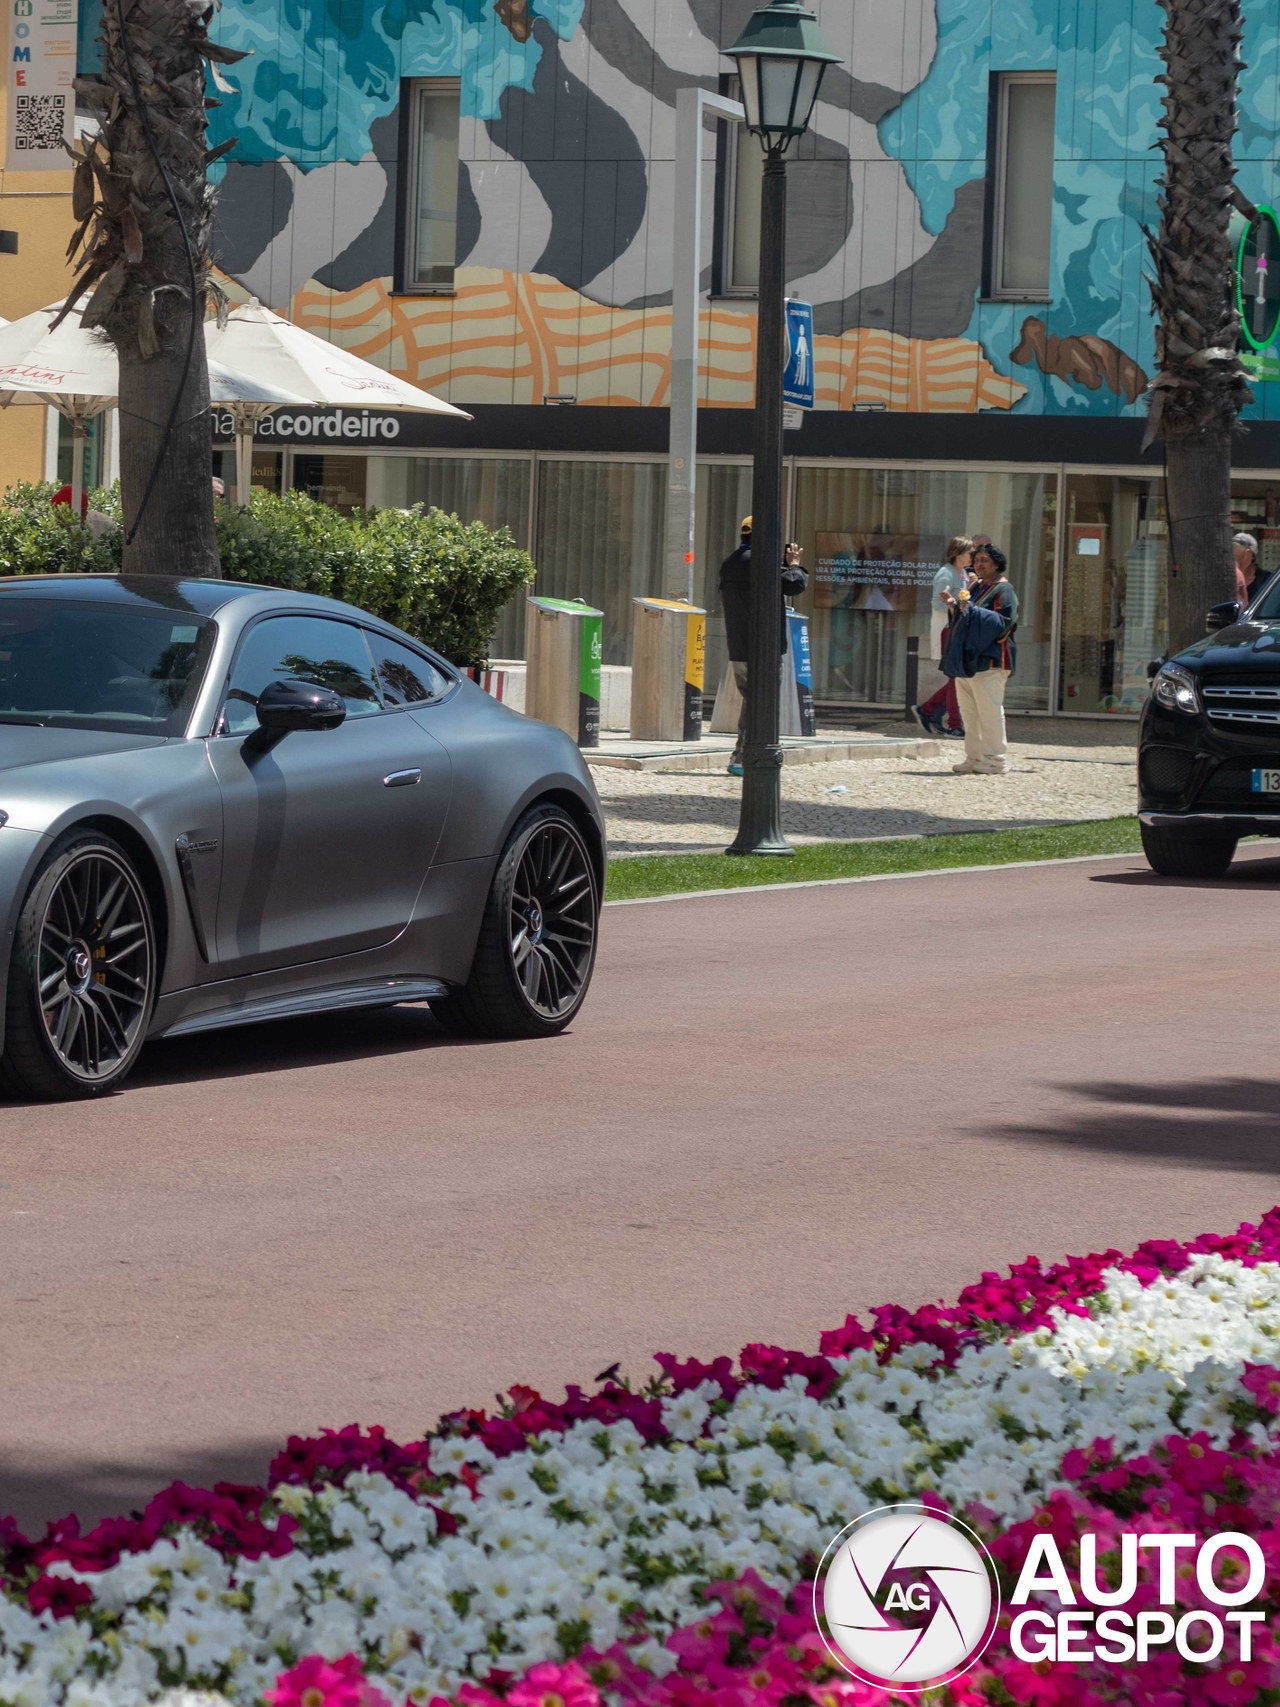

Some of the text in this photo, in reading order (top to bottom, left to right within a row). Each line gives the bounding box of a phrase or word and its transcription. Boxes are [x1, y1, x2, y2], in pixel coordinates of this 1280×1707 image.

[818, 558, 851, 566] CUIDADO
[863, 558, 901, 569] PROTEÇÃO
[848, 567, 886, 577] PROTEÇÃO
[847, 576, 891, 585] AMBIENTAIS,
